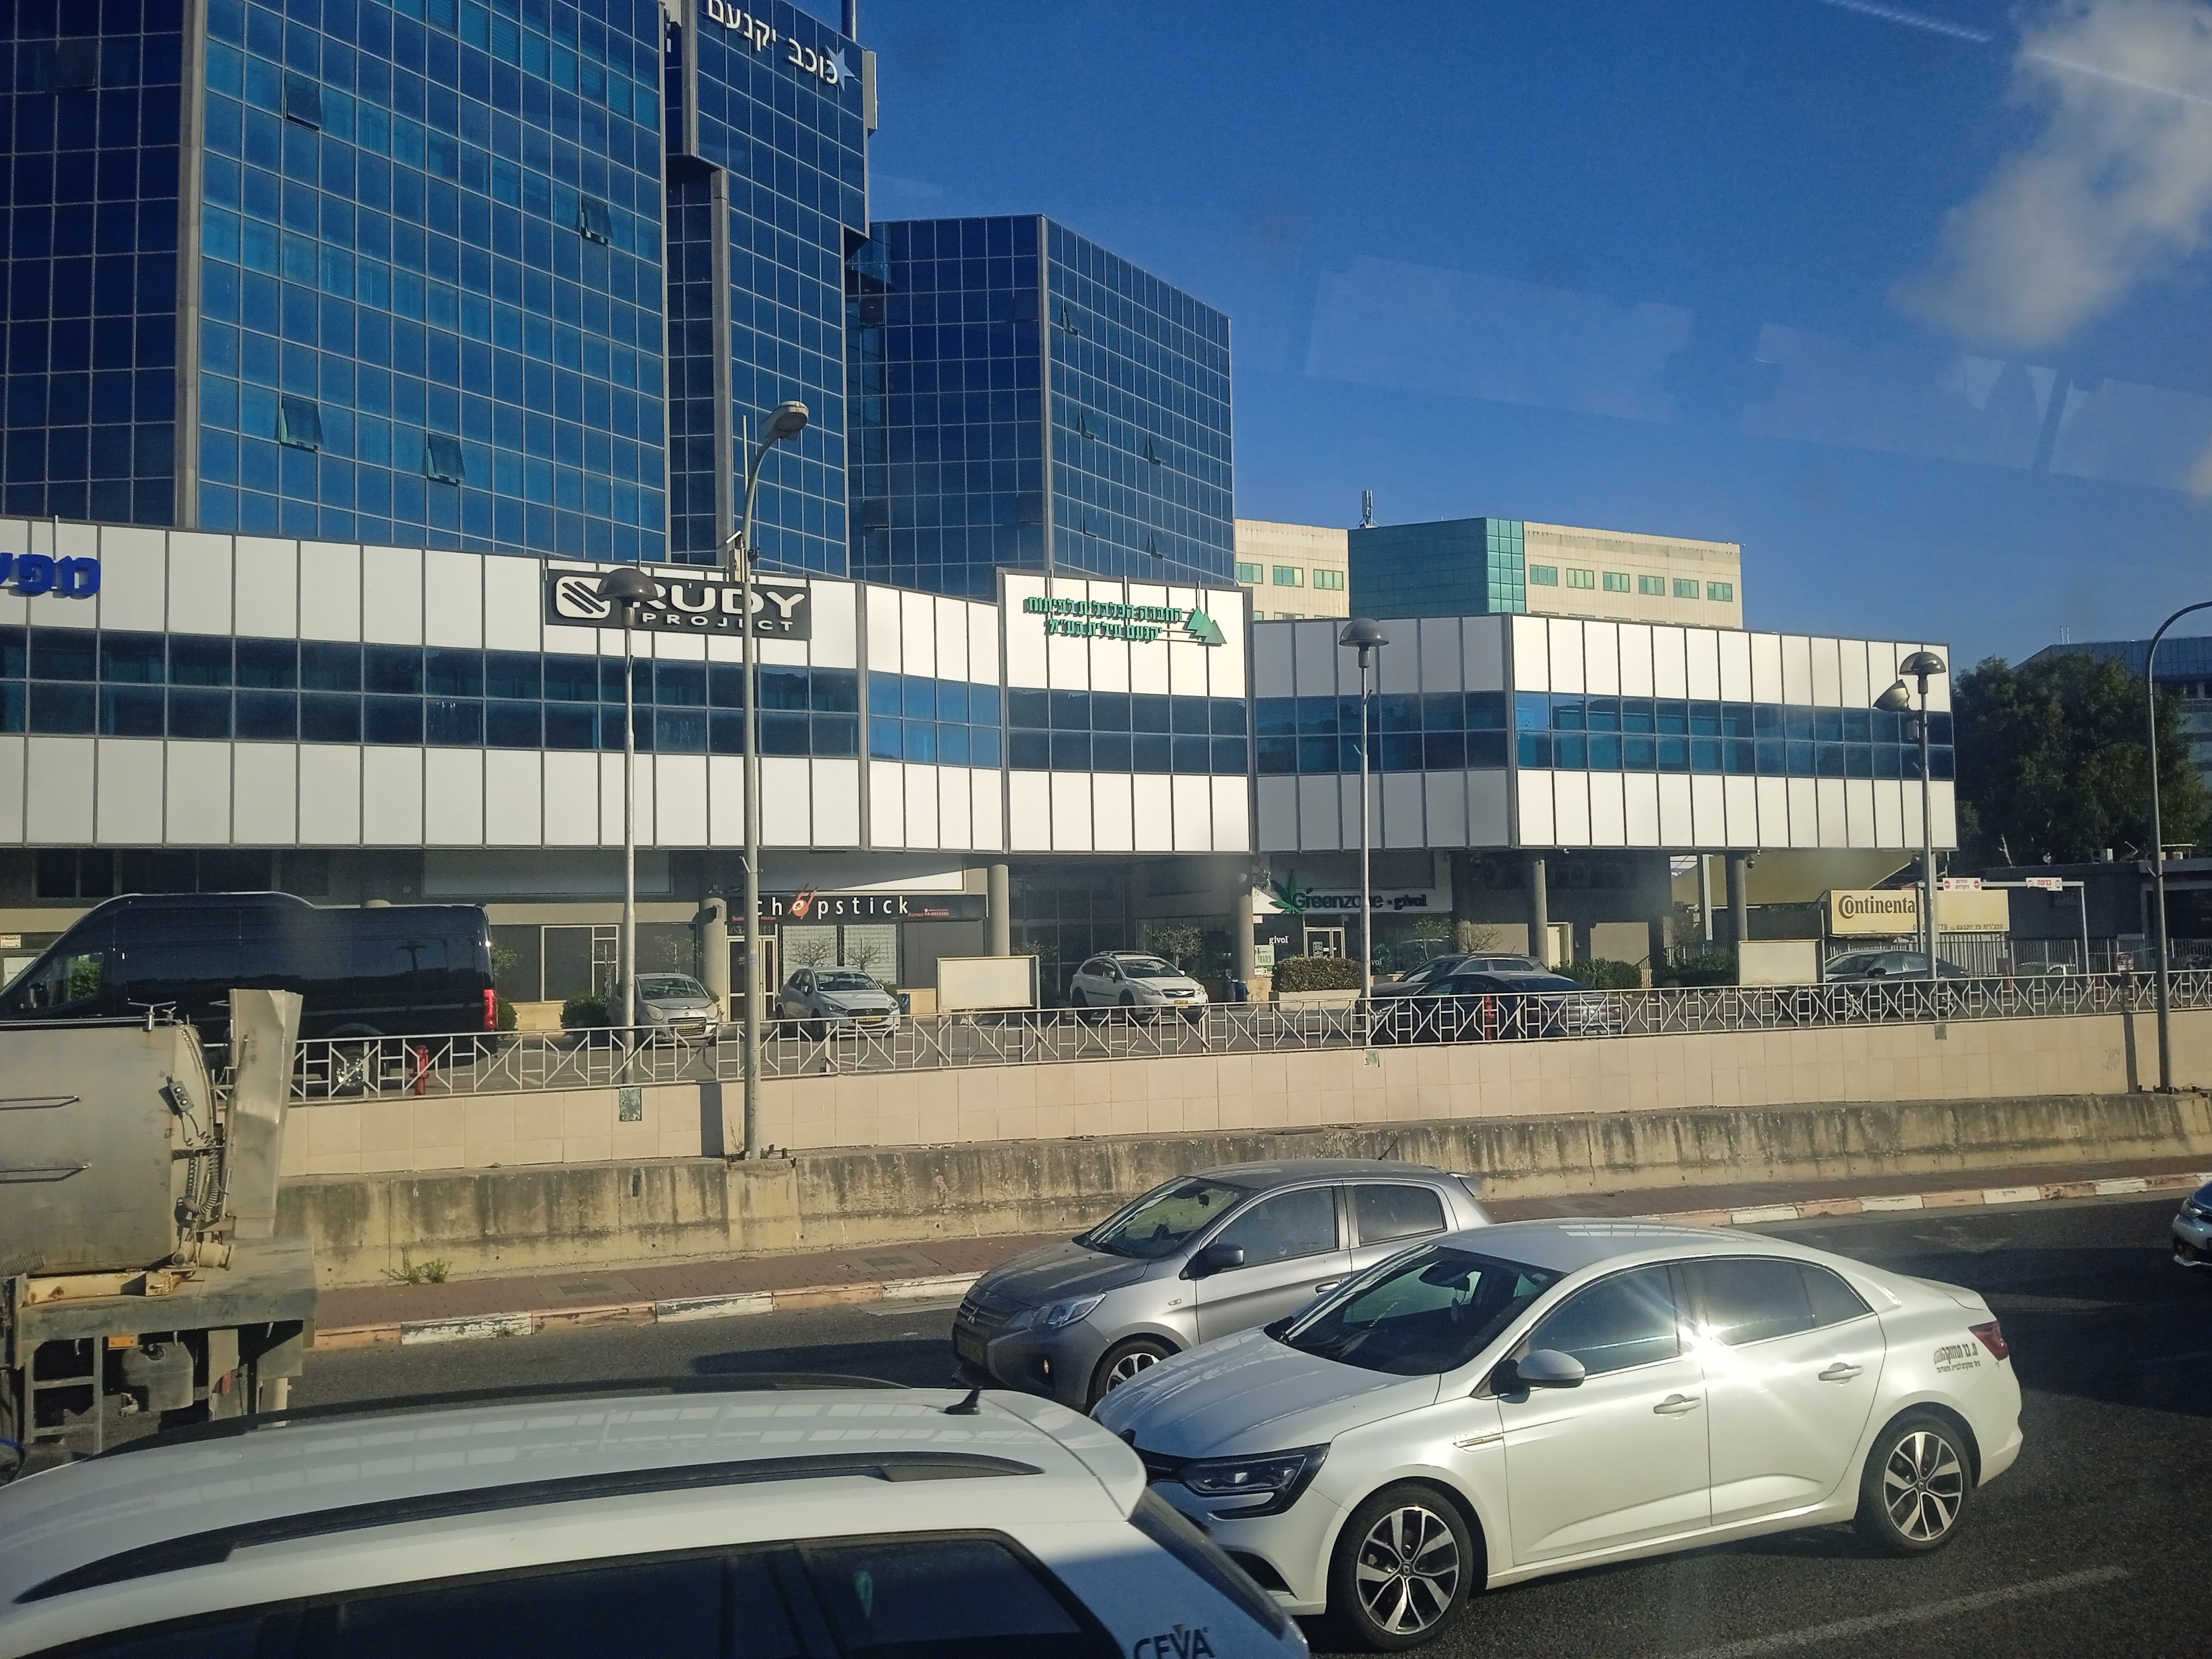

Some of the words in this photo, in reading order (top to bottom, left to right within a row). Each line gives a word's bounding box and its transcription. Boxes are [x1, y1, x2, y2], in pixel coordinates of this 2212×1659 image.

[709, 0, 777, 52] יקנעם
[788, 37, 838, 84] כוכב
[1028, 596, 1074, 613] לפיתוח
[1139, 606, 1182, 621] החברה
[642, 612, 793, 631] PROJCT
[1127, 625, 1162, 641] יקנעם
[1838, 895, 1917, 919] Continenta
[1269, 936, 1289, 944] givol
